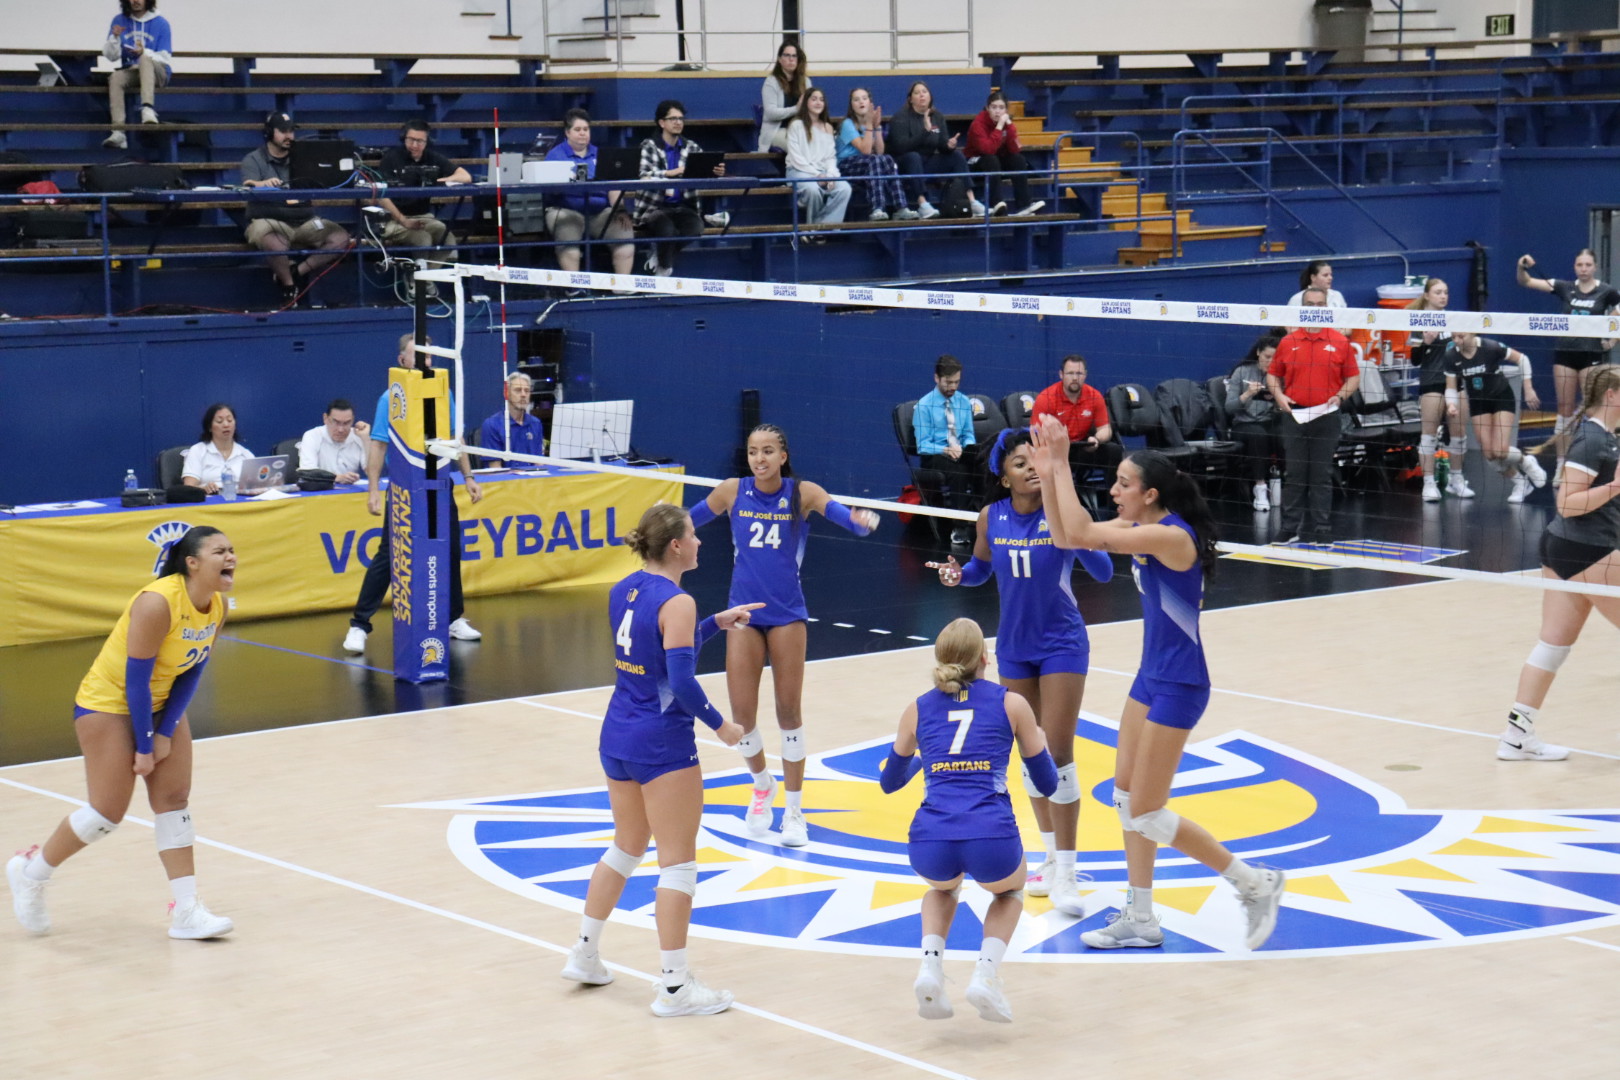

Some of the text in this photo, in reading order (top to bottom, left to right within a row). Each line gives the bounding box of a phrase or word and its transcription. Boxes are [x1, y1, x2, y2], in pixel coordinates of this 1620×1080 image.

[1491, 17, 1510, 35] EXIT
[1012, 302, 1039, 310] SPARTANS
[1101, 306, 1131, 314] SPARTANS
[1197, 311, 1229, 319] SPARTANS
[1300, 315, 1333, 323] SPARTANS
[1410, 319, 1446, 327] SPARTANS
[1529, 322, 1569, 331] SPARTANS
[391, 483, 401, 534] STATE
[320, 507, 626, 574] VOEYBALL
[749, 522, 782, 549] 24
[400, 490, 412, 625] SPARTANS
[1008, 549, 1031, 578] 11
[428, 556, 437, 631] sports imports
[616, 608, 634, 656] 4
[948, 709, 974, 754] 7
[931, 760, 991, 772] SPARTANS
